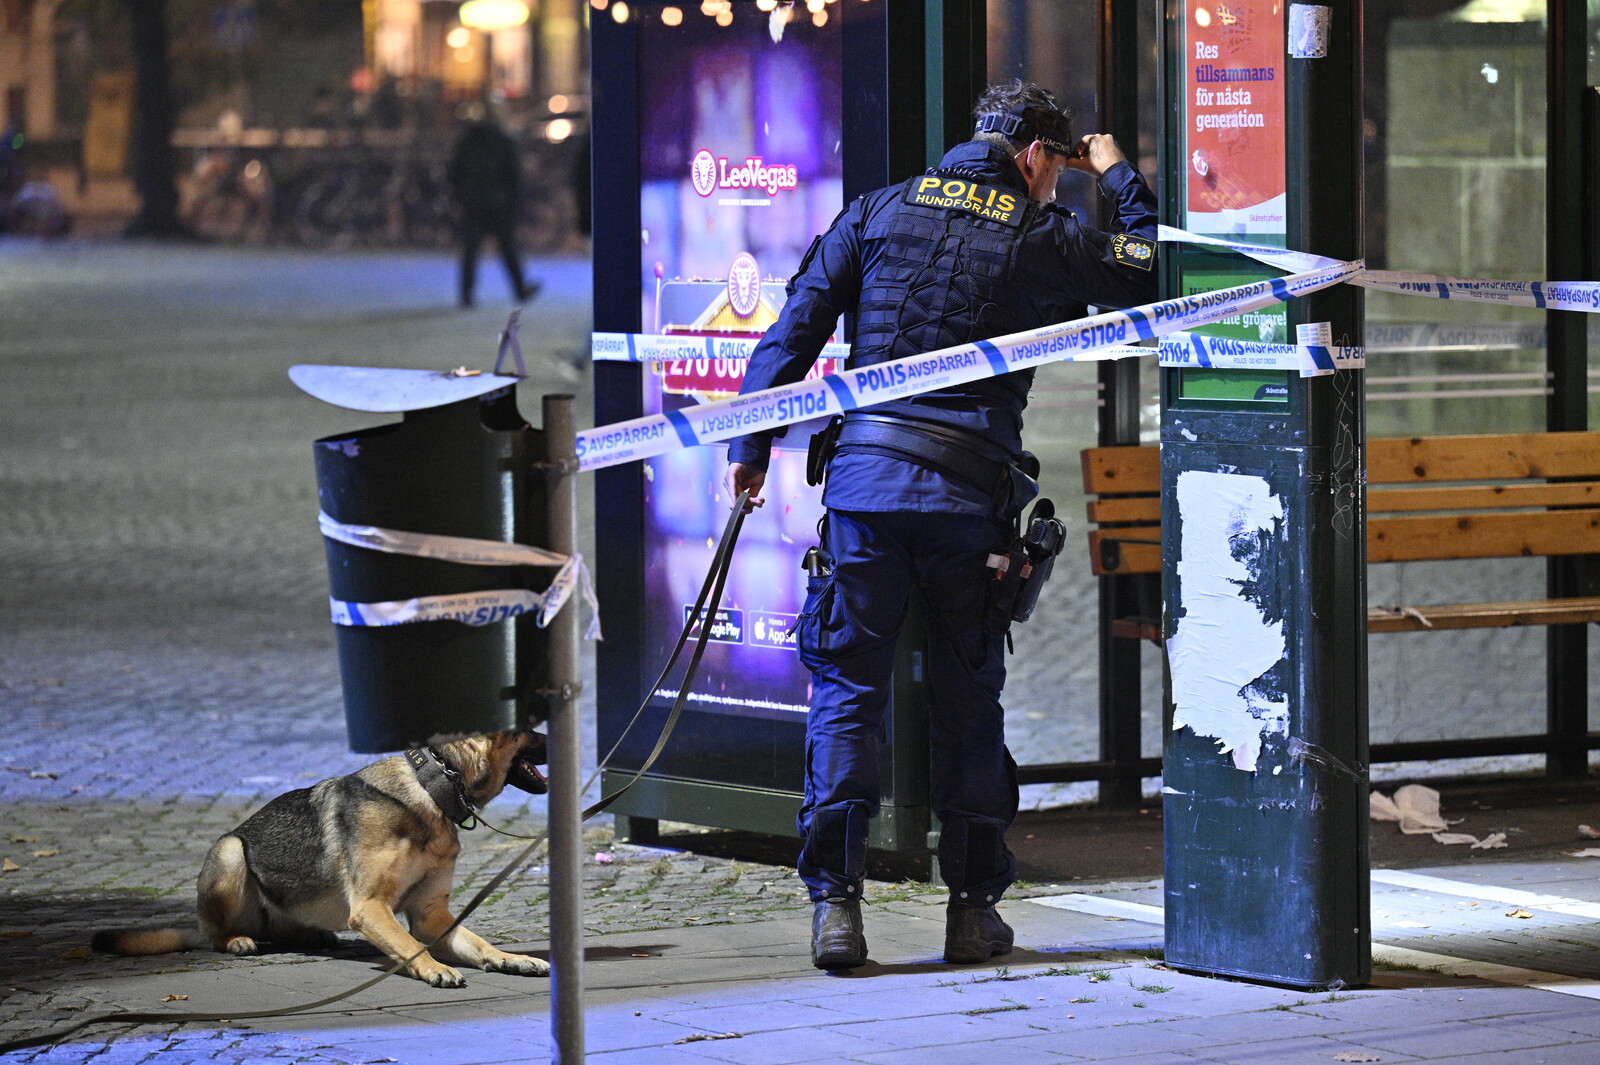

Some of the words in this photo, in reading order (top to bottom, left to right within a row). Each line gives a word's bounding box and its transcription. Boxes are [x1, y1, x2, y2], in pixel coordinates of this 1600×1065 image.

[1195, 41, 1219, 59] Res
[1196, 64, 1274, 83] tillsammans
[1196, 87, 1214, 106] för
[1216, 87, 1252, 106] nästa
[1196, 108, 1264, 132] generation
[719, 158, 797, 195] LeoVegas
[917, 177, 1017, 212] POLIS
[915, 194, 1011, 222] HUNDFÖRARE
[1114, 235, 1127, 259] POLIS
[1151, 297, 1200, 323] POLIS
[1182, 315, 1200, 325] POLICE
[1211, 310, 1221, 318] NOT
[1221, 306, 1238, 315] CROSS
[1080, 319, 1126, 349] POLIS
[1010, 332, 1079, 362] AVSPÄRRAT
[1209, 337, 1245, 356] POLIS
[855, 363, 907, 394] POLIS
[907, 351, 977, 380] AVSPÄRRAT
[889, 385, 908, 395] POLICE
[911, 382, 920, 390] DO
[920, 379, 932, 387] NOT
[777, 389, 827, 421] POLIS
[700, 404, 776, 434] AVSPÄRRAT
[588, 422, 665, 453] AVSPÄRRAT
[701, 619, 726, 638] ogle
[726, 622, 740, 639] Play
[768, 627, 785, 645] App
[408, 749, 423, 764] LIS
